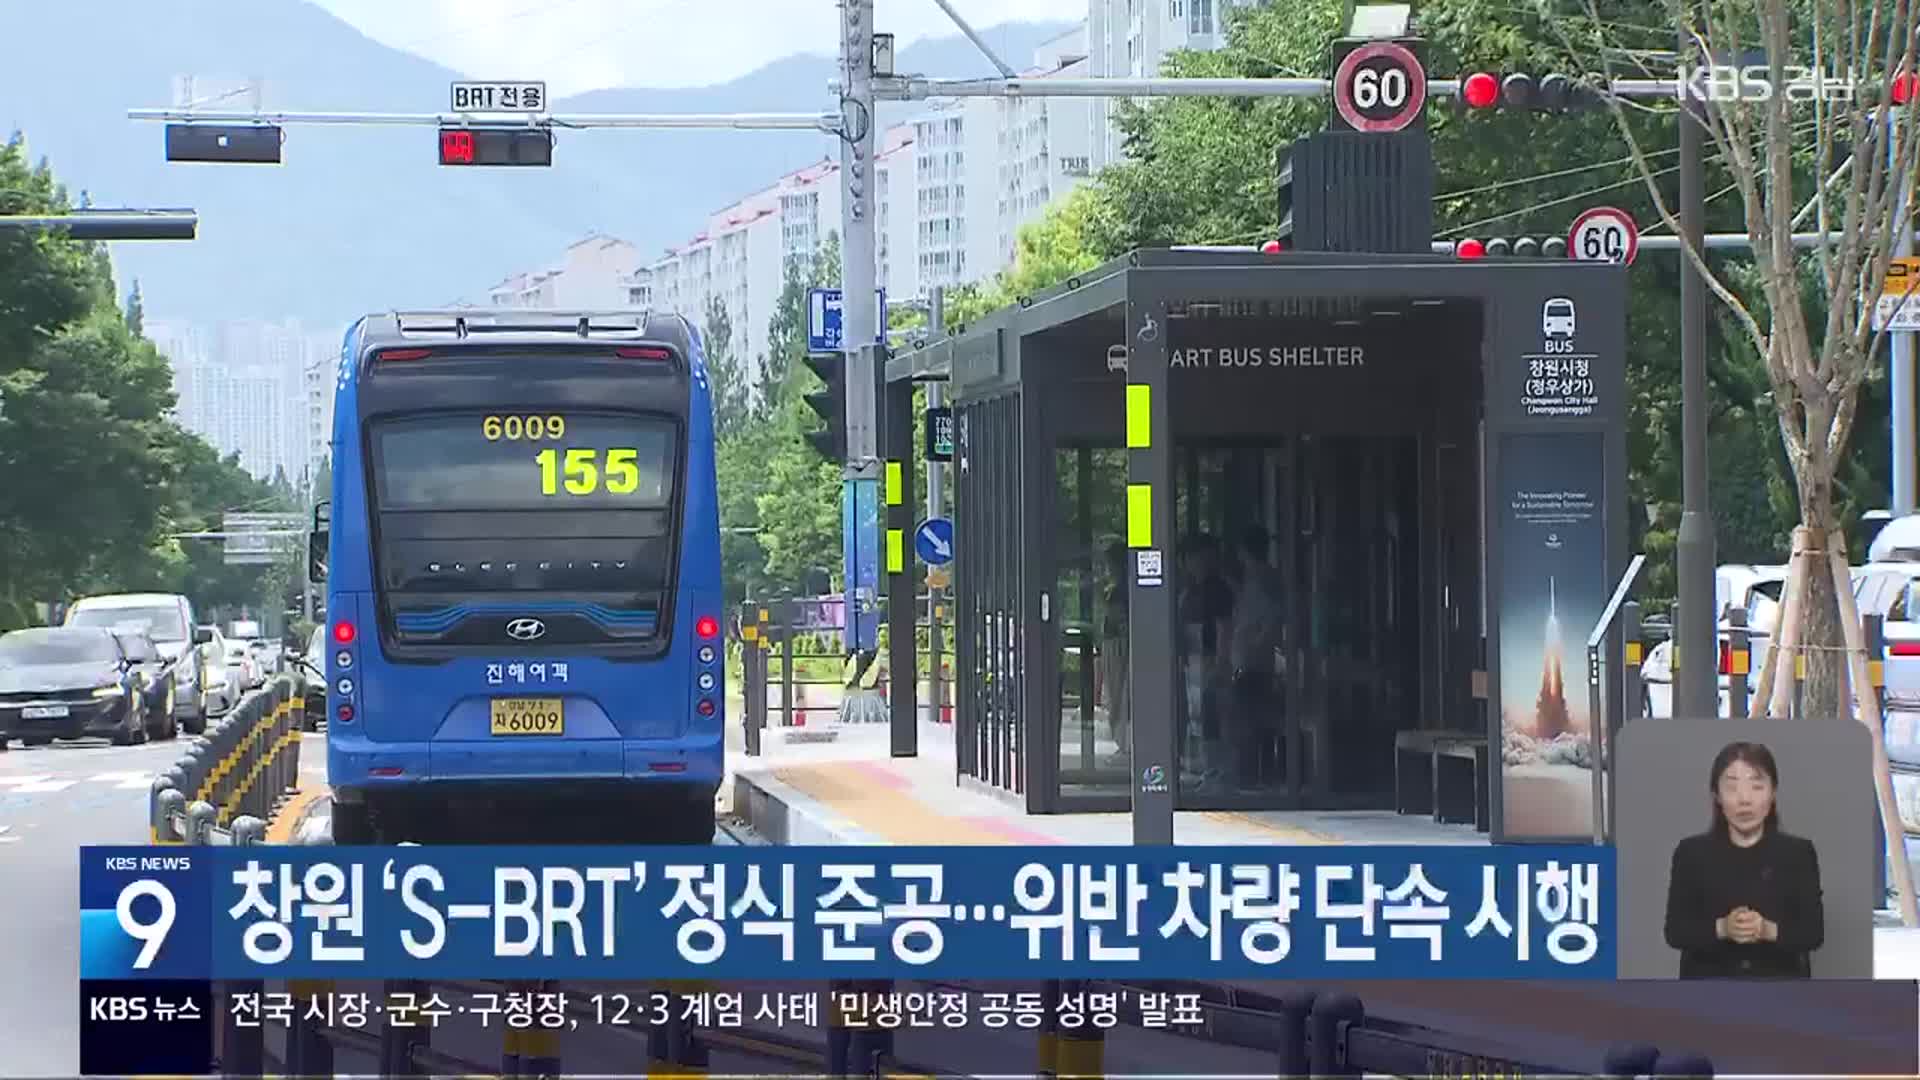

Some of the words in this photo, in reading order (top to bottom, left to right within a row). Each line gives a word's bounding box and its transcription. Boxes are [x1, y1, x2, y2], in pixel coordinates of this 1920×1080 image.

[455, 86, 495, 109] BRT
[499, 86, 541, 108] 전용
[1353, 68, 1407, 109] 60
[1583, 226, 1621, 260] 60
[1219, 349, 1263, 367] BUS
[1268, 346, 1365, 367] SHELTER
[1544, 339, 1574, 354] BUS
[1529, 359, 1589, 378] 창원시청
[1525, 378, 1594, 396] (정우상가)
[1564, 396, 1581, 406] City
[1582, 396, 1599, 405] Hall
[483, 415, 566, 441] 6009
[535, 449, 640, 496] 155
[486, 662, 569, 685] 진해여객
